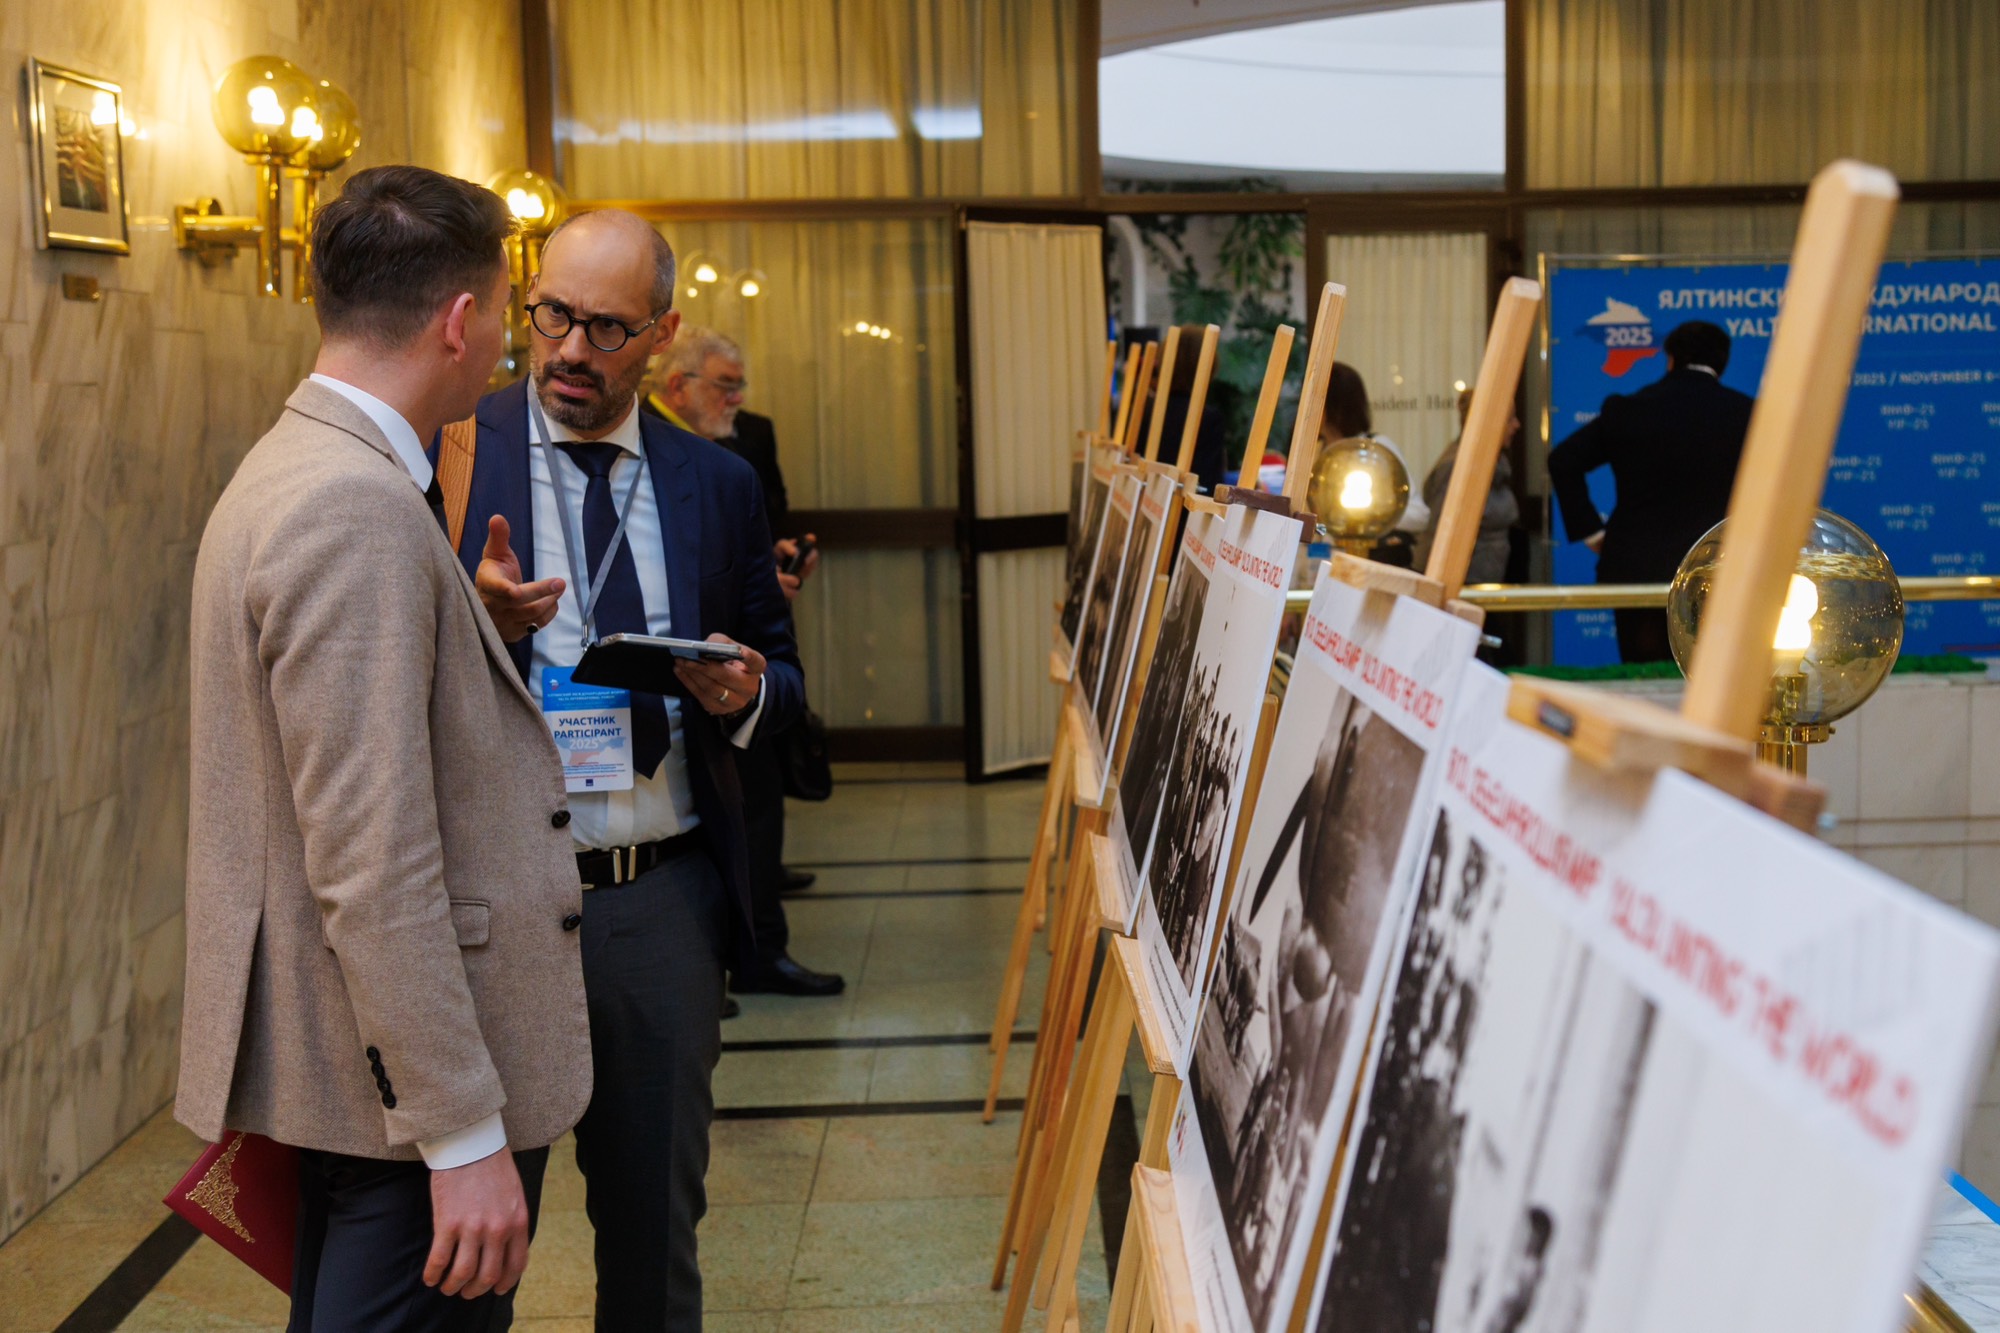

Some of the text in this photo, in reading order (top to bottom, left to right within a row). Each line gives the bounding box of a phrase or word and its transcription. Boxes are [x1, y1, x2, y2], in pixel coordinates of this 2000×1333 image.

[1658, 282, 2000, 309] ЯЛТИНСК ДУНАРОД
[1726, 313, 1997, 338] YALT RNATIONAL
[1605, 327, 1652, 346] 2025
[1854, 373, 1886, 386] 2025
[1900, 370, 1981, 384] NOVEMBER
[1373, 395, 1455, 410] sident Hot
[559, 716, 616, 726] УЧАСТНИК
[554, 728, 622, 739] PARTICIPANT
[569, 739, 599, 750] 2025
